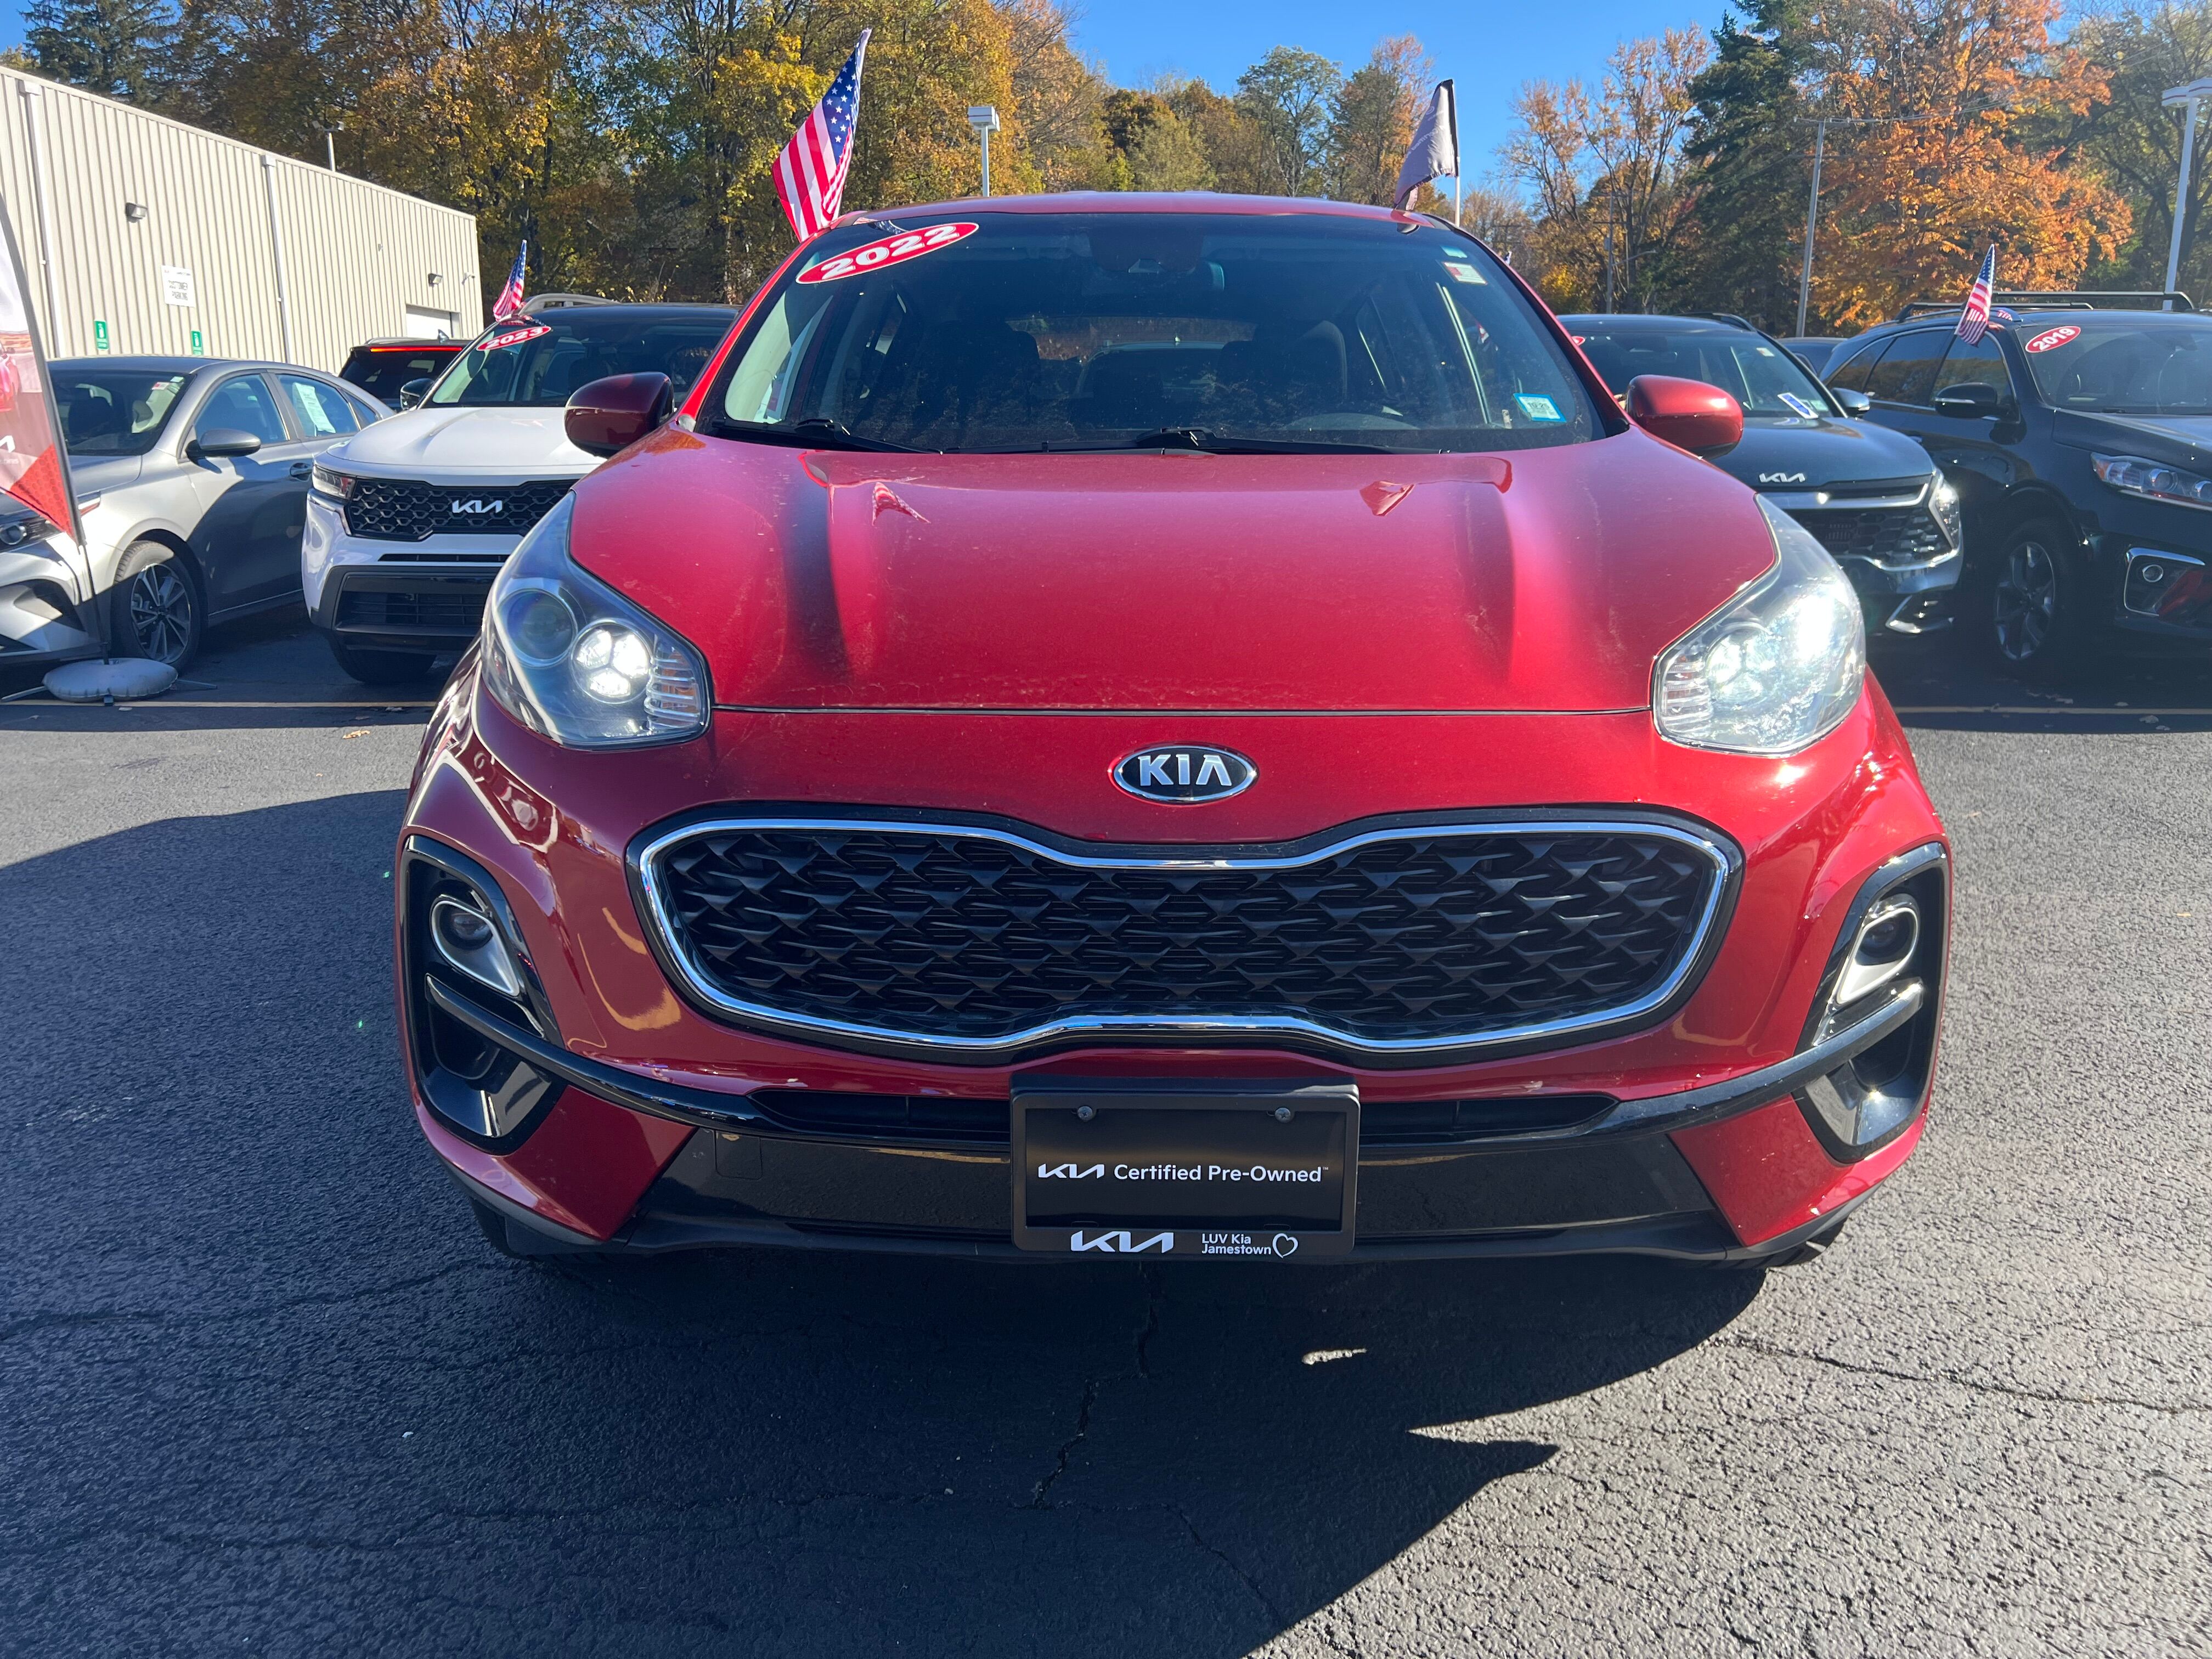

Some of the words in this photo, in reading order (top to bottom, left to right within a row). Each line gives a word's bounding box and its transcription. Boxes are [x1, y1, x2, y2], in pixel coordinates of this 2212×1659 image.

[821, 226, 960, 280] 2022
[486, 328, 543, 349] 2023
[2033, 328, 2075, 350] 2019
[1759, 473, 1805, 482] KIA
[452, 500, 503, 513] KIA
[1138, 754, 1232, 786] KIA
[1038, 1163, 1105, 1179] KIA
[1114, 1164, 1201, 1180] Certified
[1071, 1231, 1174, 1254] KIA
[1201, 1233, 1228, 1244] LUV
[1232, 1234, 1251, 1244] Kia
[1201, 1244, 1272, 1255] Jamestown
